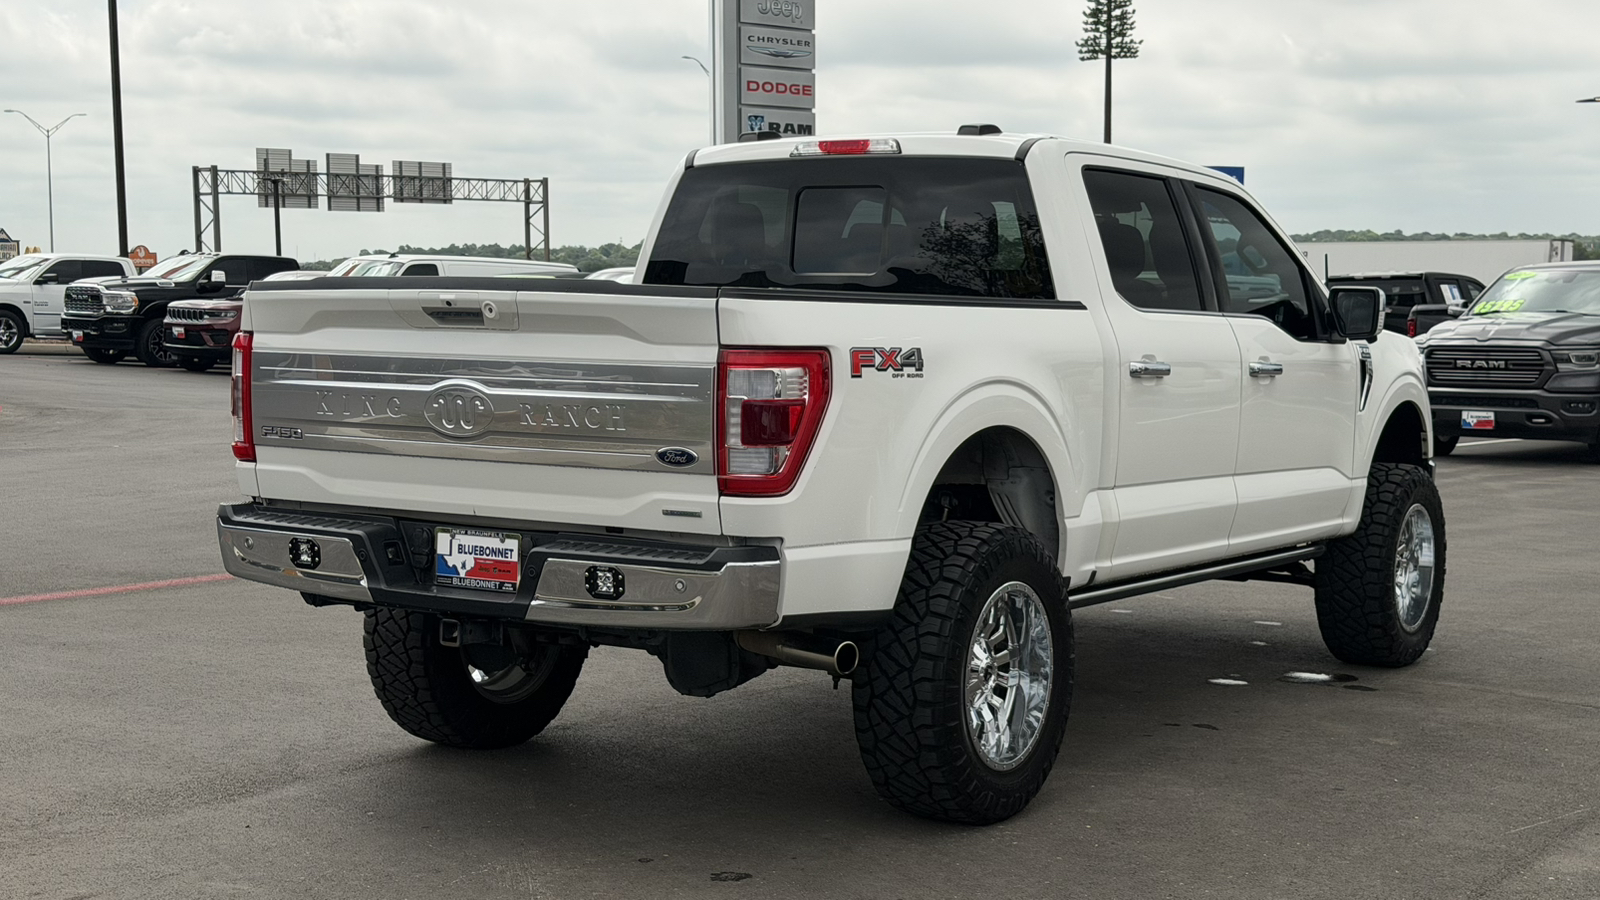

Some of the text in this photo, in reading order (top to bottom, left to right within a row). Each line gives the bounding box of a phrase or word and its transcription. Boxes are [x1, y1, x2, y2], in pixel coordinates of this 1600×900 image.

[757, 0, 803, 23] Jeep
[747, 35, 811, 47] CHRYSLER
[746, 80, 813, 96] DODGE
[768, 121, 812, 135] RAM
[849, 346, 924, 378] FX4
[1456, 360, 1505, 368] RAM
[316, 389, 626, 431] KING RANCH
[261, 425, 303, 440] F-150
[663, 450, 687, 463] Ford
[468, 530, 504, 538] BRAUNFELS
[457, 543, 514, 560] BLUEBONNET
[452, 577, 500, 589] BLUEBONNET
